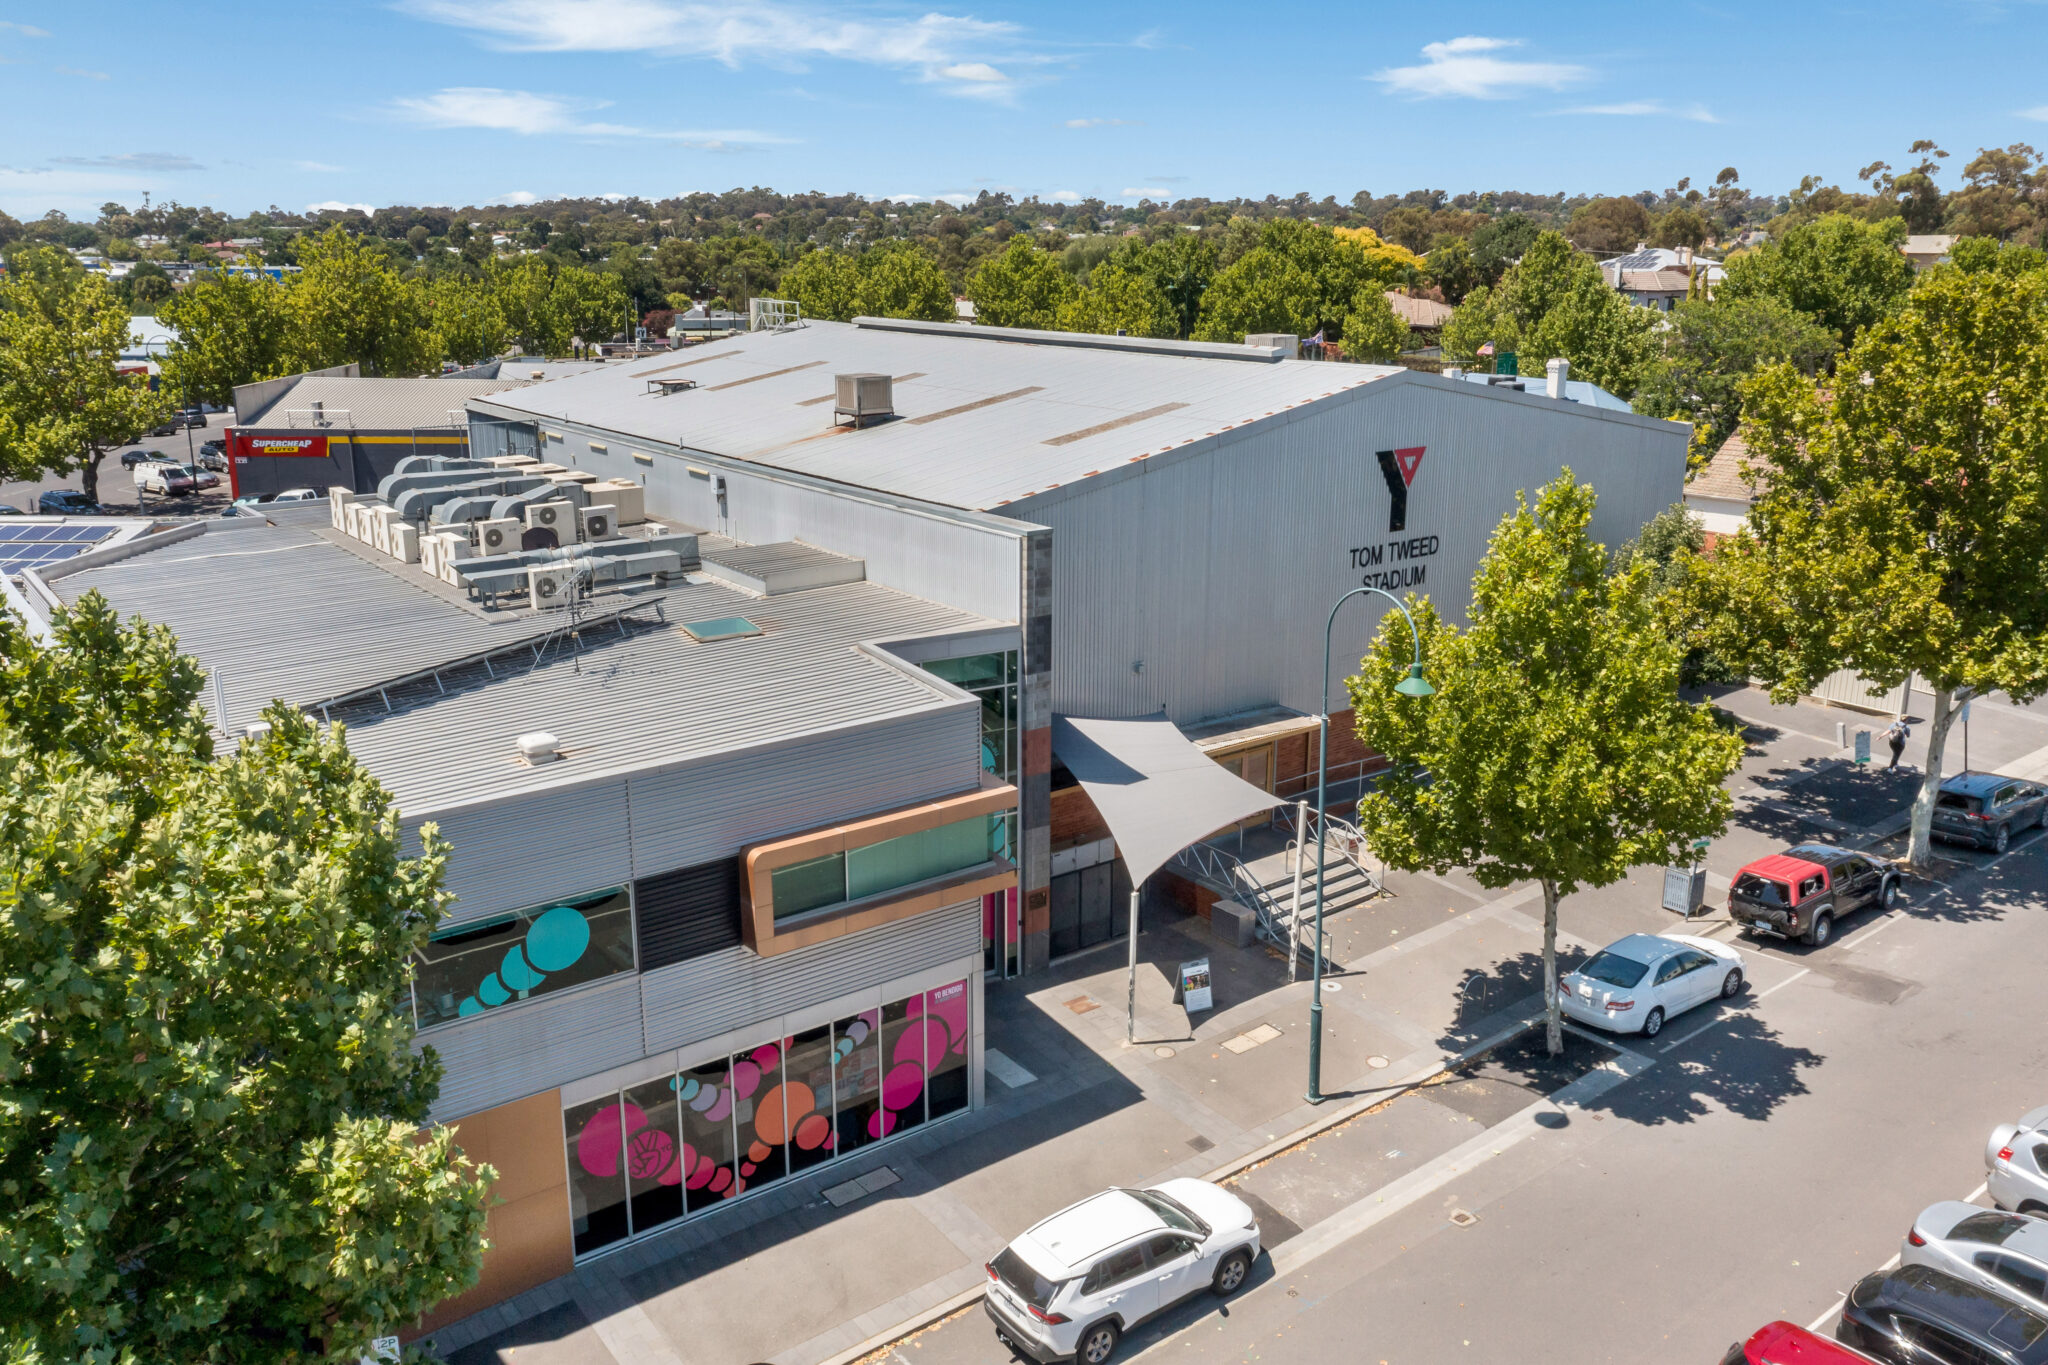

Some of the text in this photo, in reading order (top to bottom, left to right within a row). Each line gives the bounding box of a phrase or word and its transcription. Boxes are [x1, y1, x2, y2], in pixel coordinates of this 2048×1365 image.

[252, 439, 312, 448] SUPERCHEAP
[1350, 535, 1439, 569] TOM TWEED
[1363, 564, 1426, 595] STADIUM
[942, 984, 963, 997] BENDIGO
